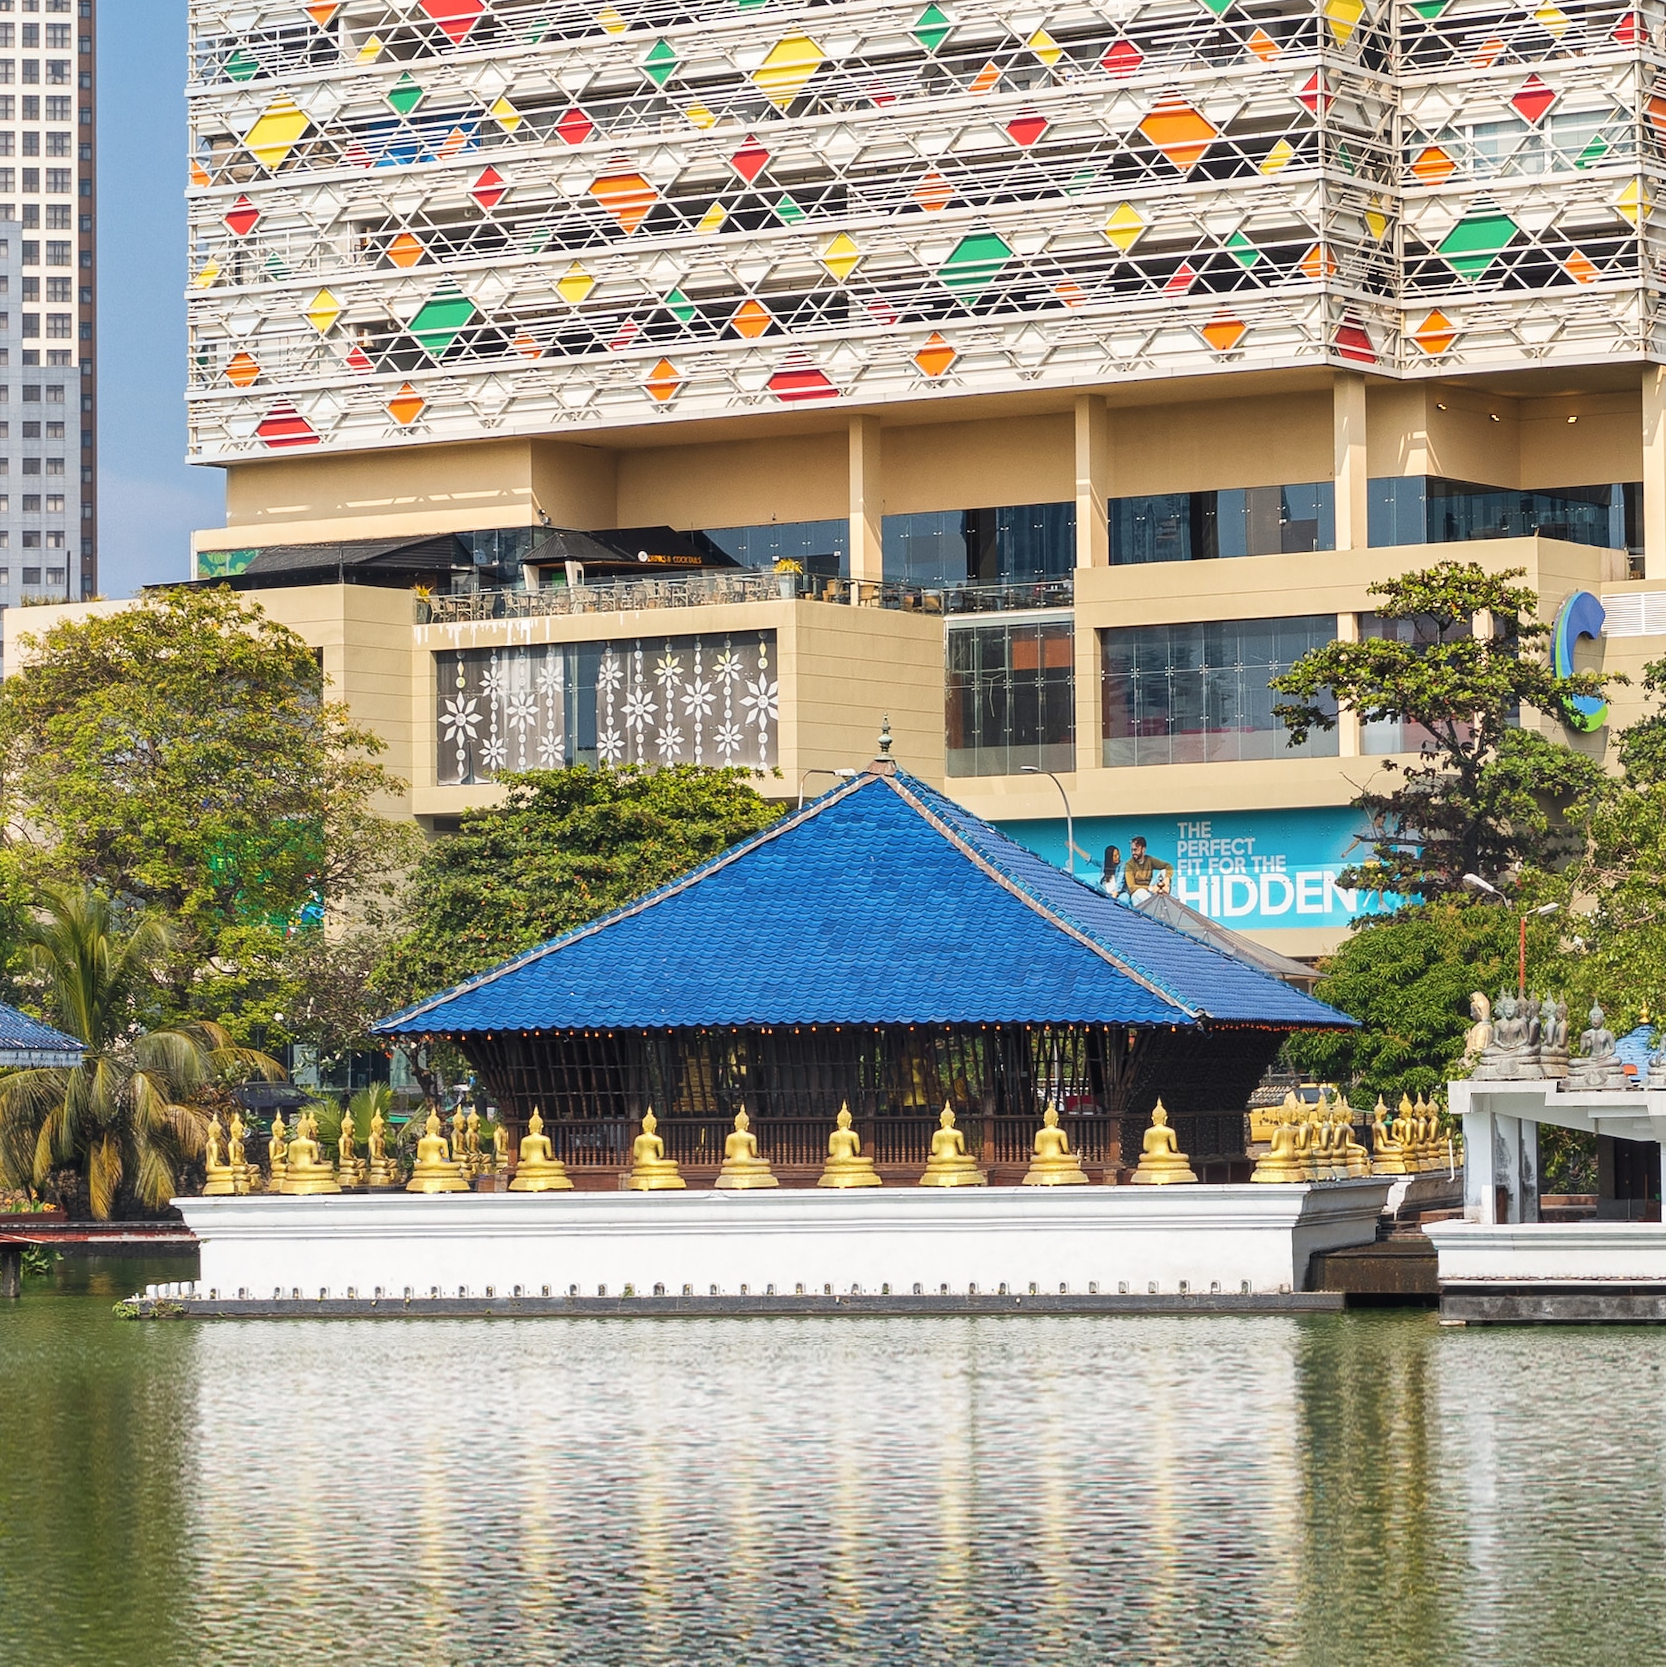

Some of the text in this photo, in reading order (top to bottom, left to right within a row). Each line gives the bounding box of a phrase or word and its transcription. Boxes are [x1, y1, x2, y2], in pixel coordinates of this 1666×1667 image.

[1177, 821, 1212, 838] THE
[1177, 837, 1256, 857] PERFECT
[1177, 854, 1287, 876] FIT FOR THE
[1177, 870, 1357, 917] HIDDEN
